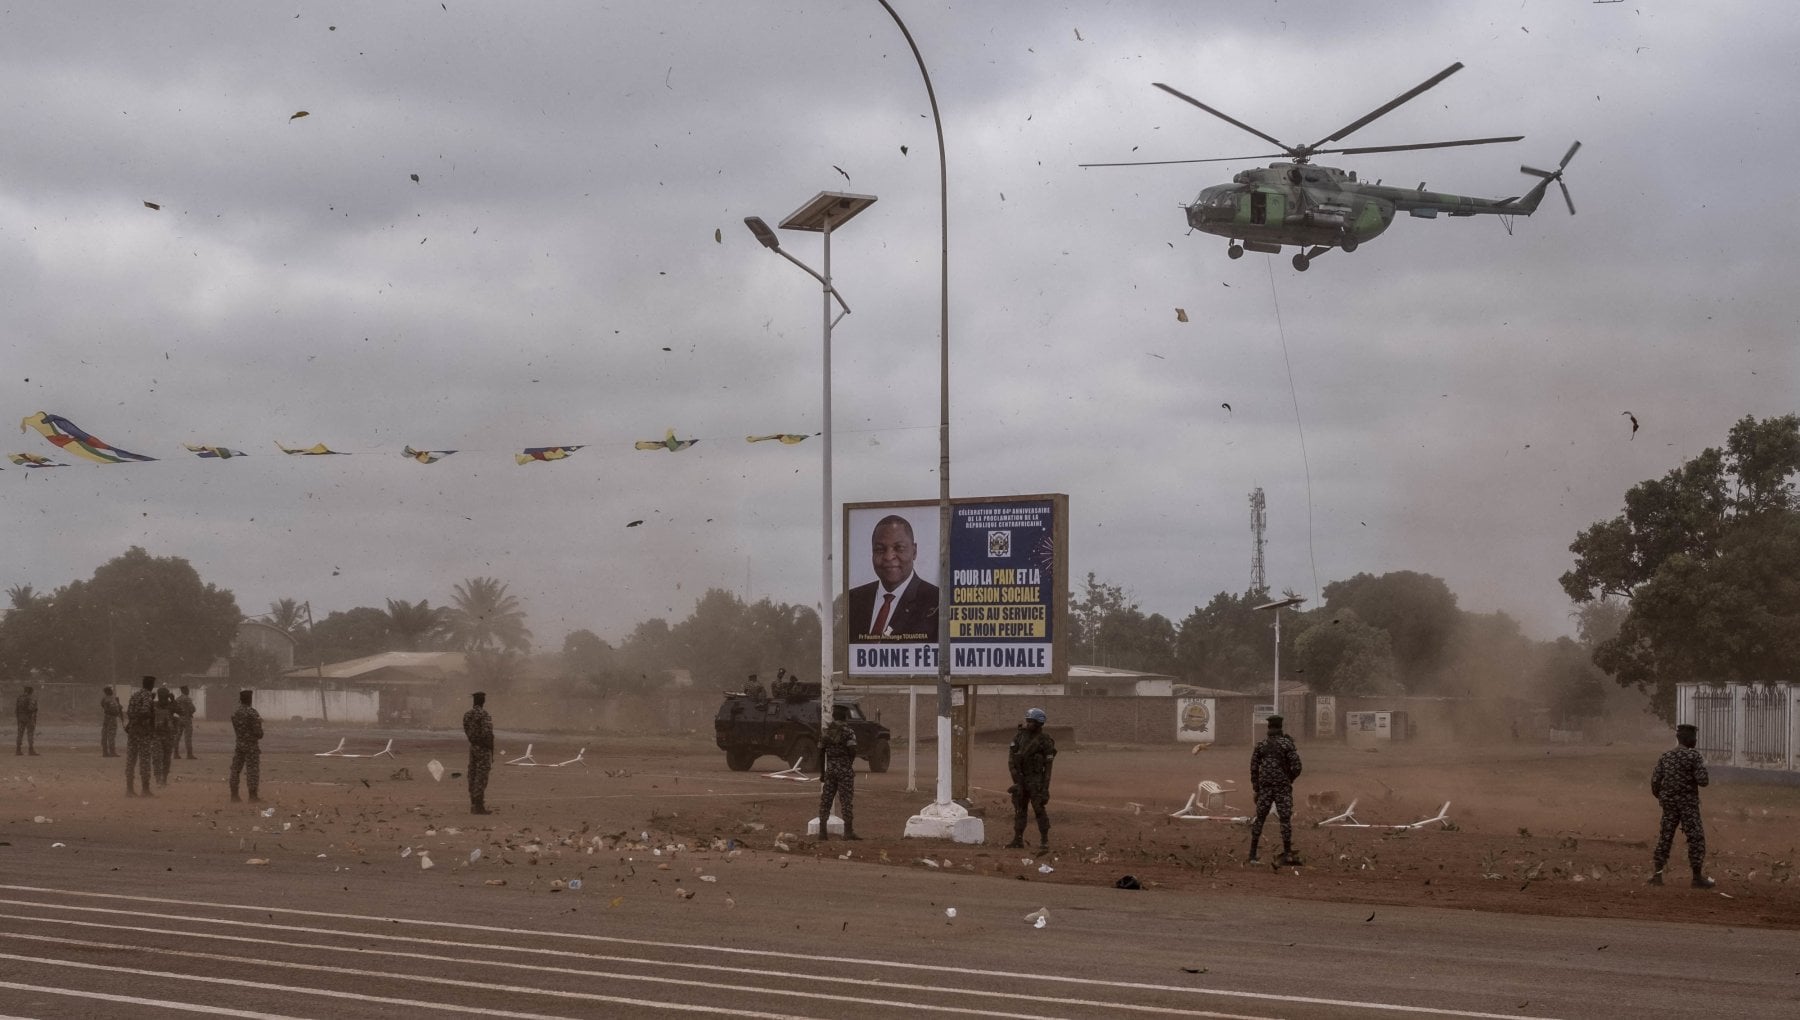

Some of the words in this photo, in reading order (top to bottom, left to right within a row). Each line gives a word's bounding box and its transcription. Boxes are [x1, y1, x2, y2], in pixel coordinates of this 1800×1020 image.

[954, 569, 979, 586] POUR
[981, 569, 992, 585] LA
[994, 568, 1015, 585] PAIX
[1016, 568, 1027, 584] ET
[1028, 568, 1040, 584] LA
[954, 585, 1000, 603] COHÉSION
[1001, 586, 1040, 602] SOCIALE
[950, 608, 959, 620] JE
[961, 607, 985, 620] SUIS
[986, 607, 1000, 620] AU
[1002, 606, 1044, 620] SERVICE
[960, 623, 972, 636] DE
[974, 623, 996, 636] MON
[998, 622, 1034, 636] PEUPLE
[856, 648, 910, 668] BONNE
[915, 644, 938, 667] FÊT
[955, 648, 1044, 668] NATIONALE
